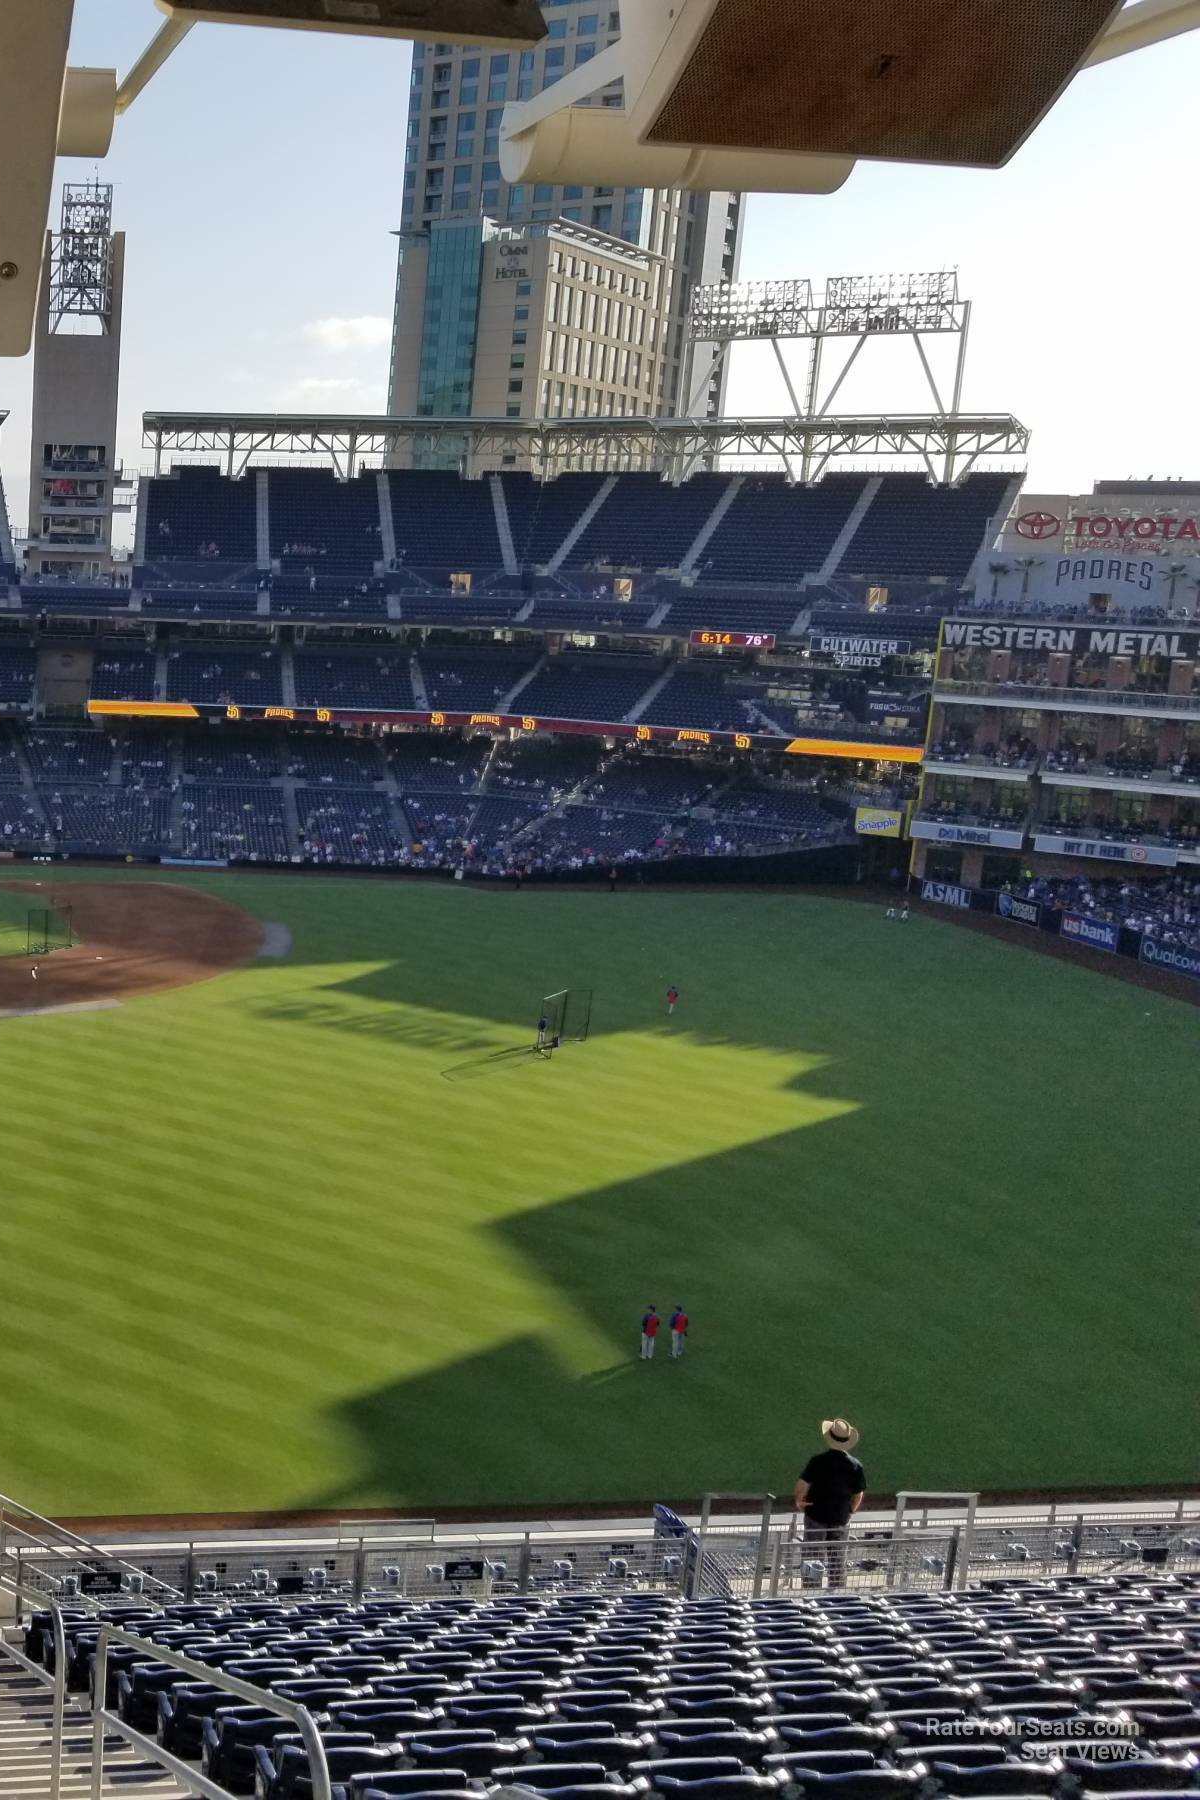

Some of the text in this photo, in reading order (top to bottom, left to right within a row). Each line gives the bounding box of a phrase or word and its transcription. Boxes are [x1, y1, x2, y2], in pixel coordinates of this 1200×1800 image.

[1071, 516, 1200, 539] TOYOTA
[1055, 558, 1154, 591] PADRES
[700, 632, 733, 645] 6:14
[820, 637, 898, 655] CUTWATER
[944, 623, 1076, 651] WESTERN
[1089, 631, 1187, 658] METAL
[834, 654, 882, 667] SPIRITS
[857, 817, 897, 831] Snapple
[956, 828, 991, 844] Mitel
[923, 881, 971, 909] ASML
